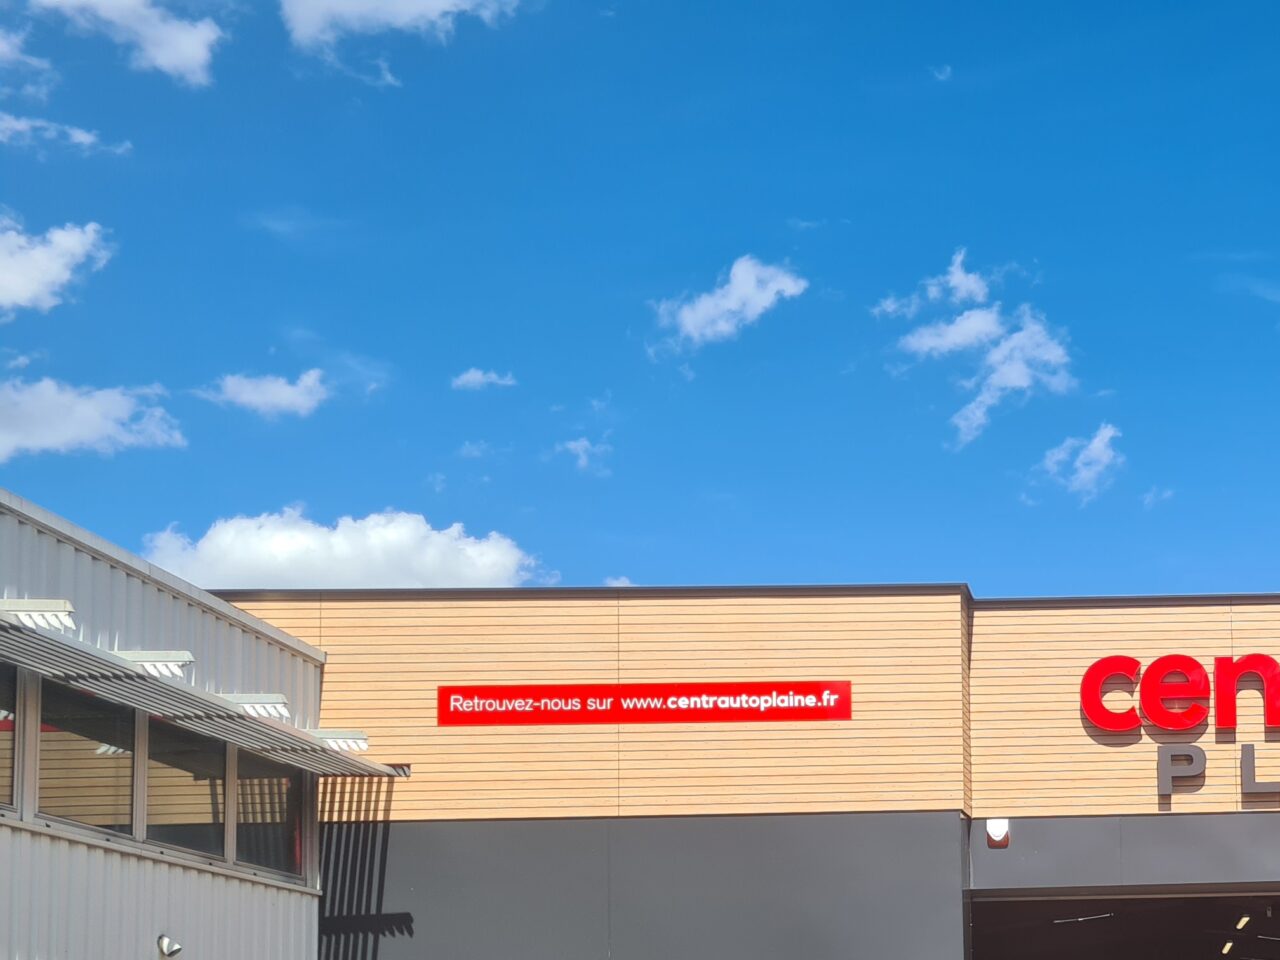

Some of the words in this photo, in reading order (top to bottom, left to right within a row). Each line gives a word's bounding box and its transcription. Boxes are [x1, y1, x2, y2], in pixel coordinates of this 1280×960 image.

[449, 694, 582, 713] Retrouvez-nous
[586, 695, 614, 711] sur
[620, 690, 840, 713] www.centrautoplaine.fr
